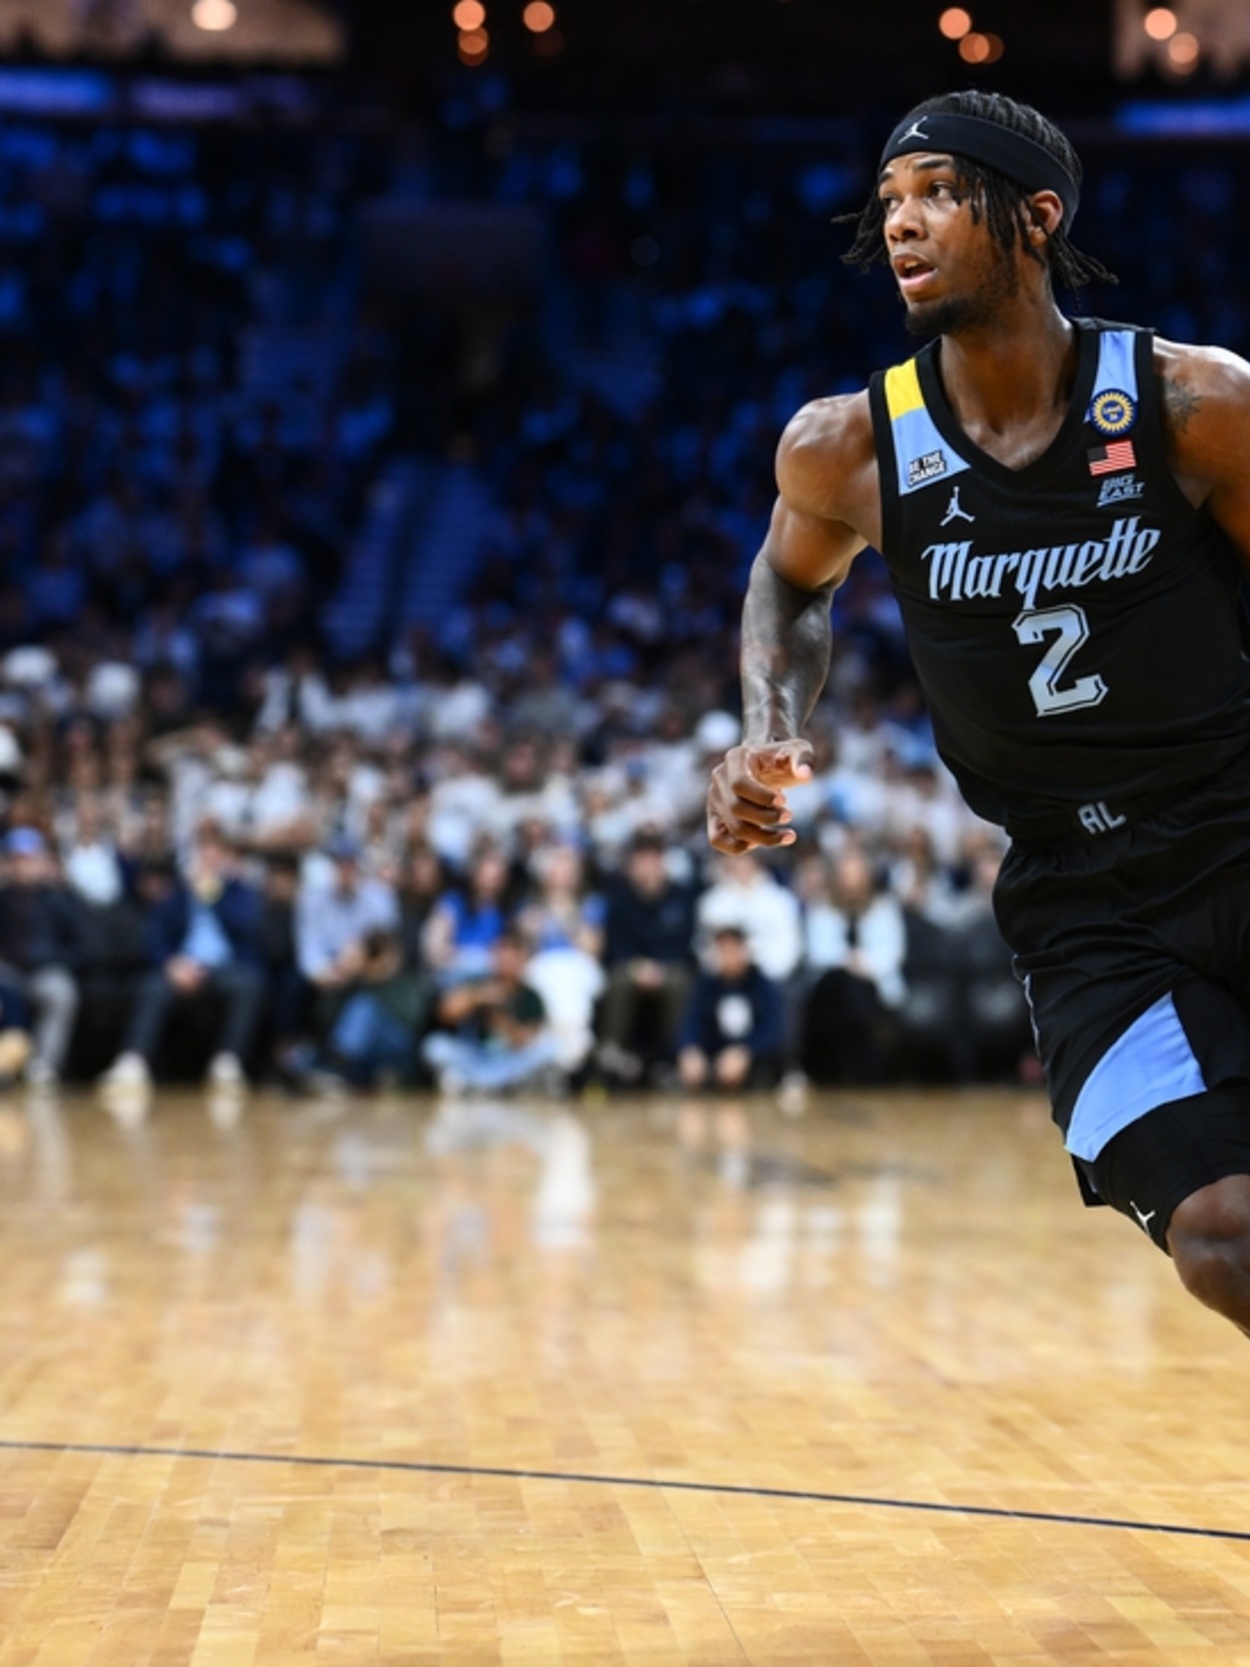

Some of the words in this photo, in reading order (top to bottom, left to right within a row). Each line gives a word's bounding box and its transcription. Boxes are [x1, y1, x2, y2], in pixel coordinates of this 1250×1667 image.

[1098, 481, 1145, 502] EAST
[1102, 473, 1134, 491] BIG
[921, 515, 1161, 610] Marquette
[1011, 603, 1109, 717] 2
